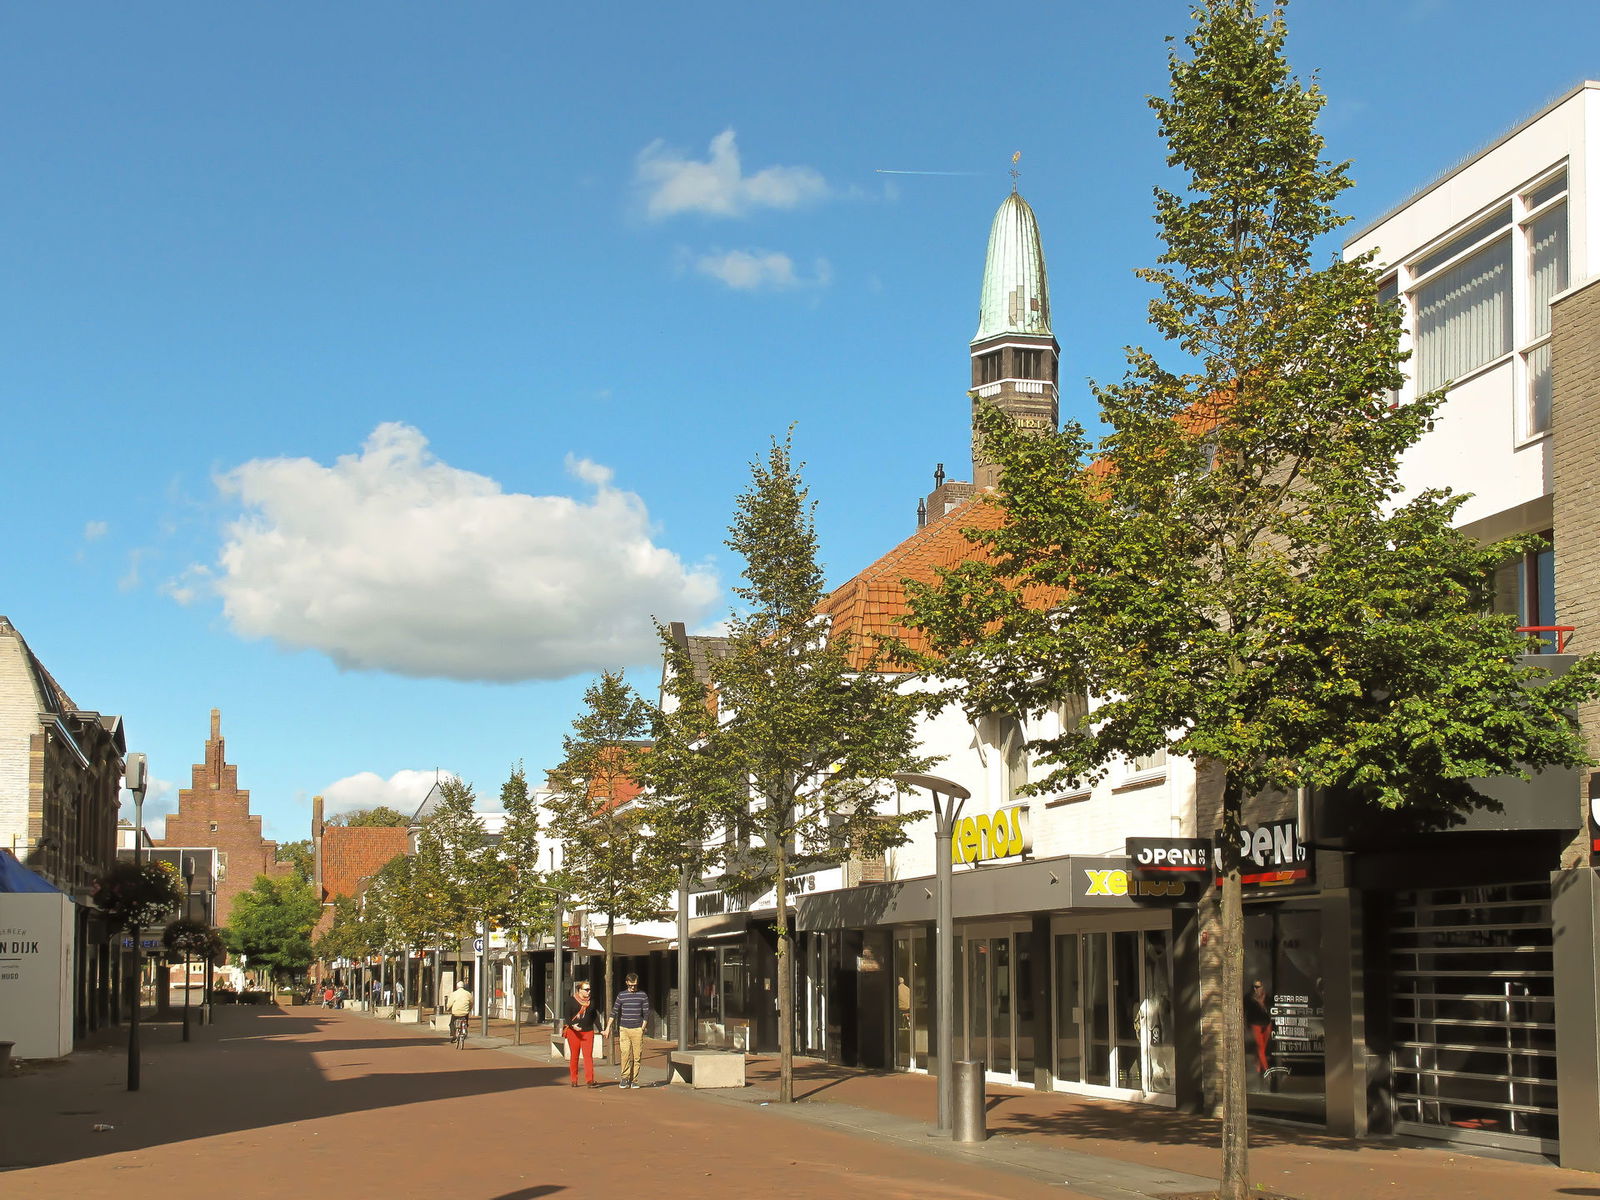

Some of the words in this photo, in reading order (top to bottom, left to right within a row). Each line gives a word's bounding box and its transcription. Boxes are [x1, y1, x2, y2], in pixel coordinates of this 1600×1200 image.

[1214, 823, 1293, 870] PEN
[1137, 848, 1197, 865] OPEN
[12, 941, 40, 954] DIJK
